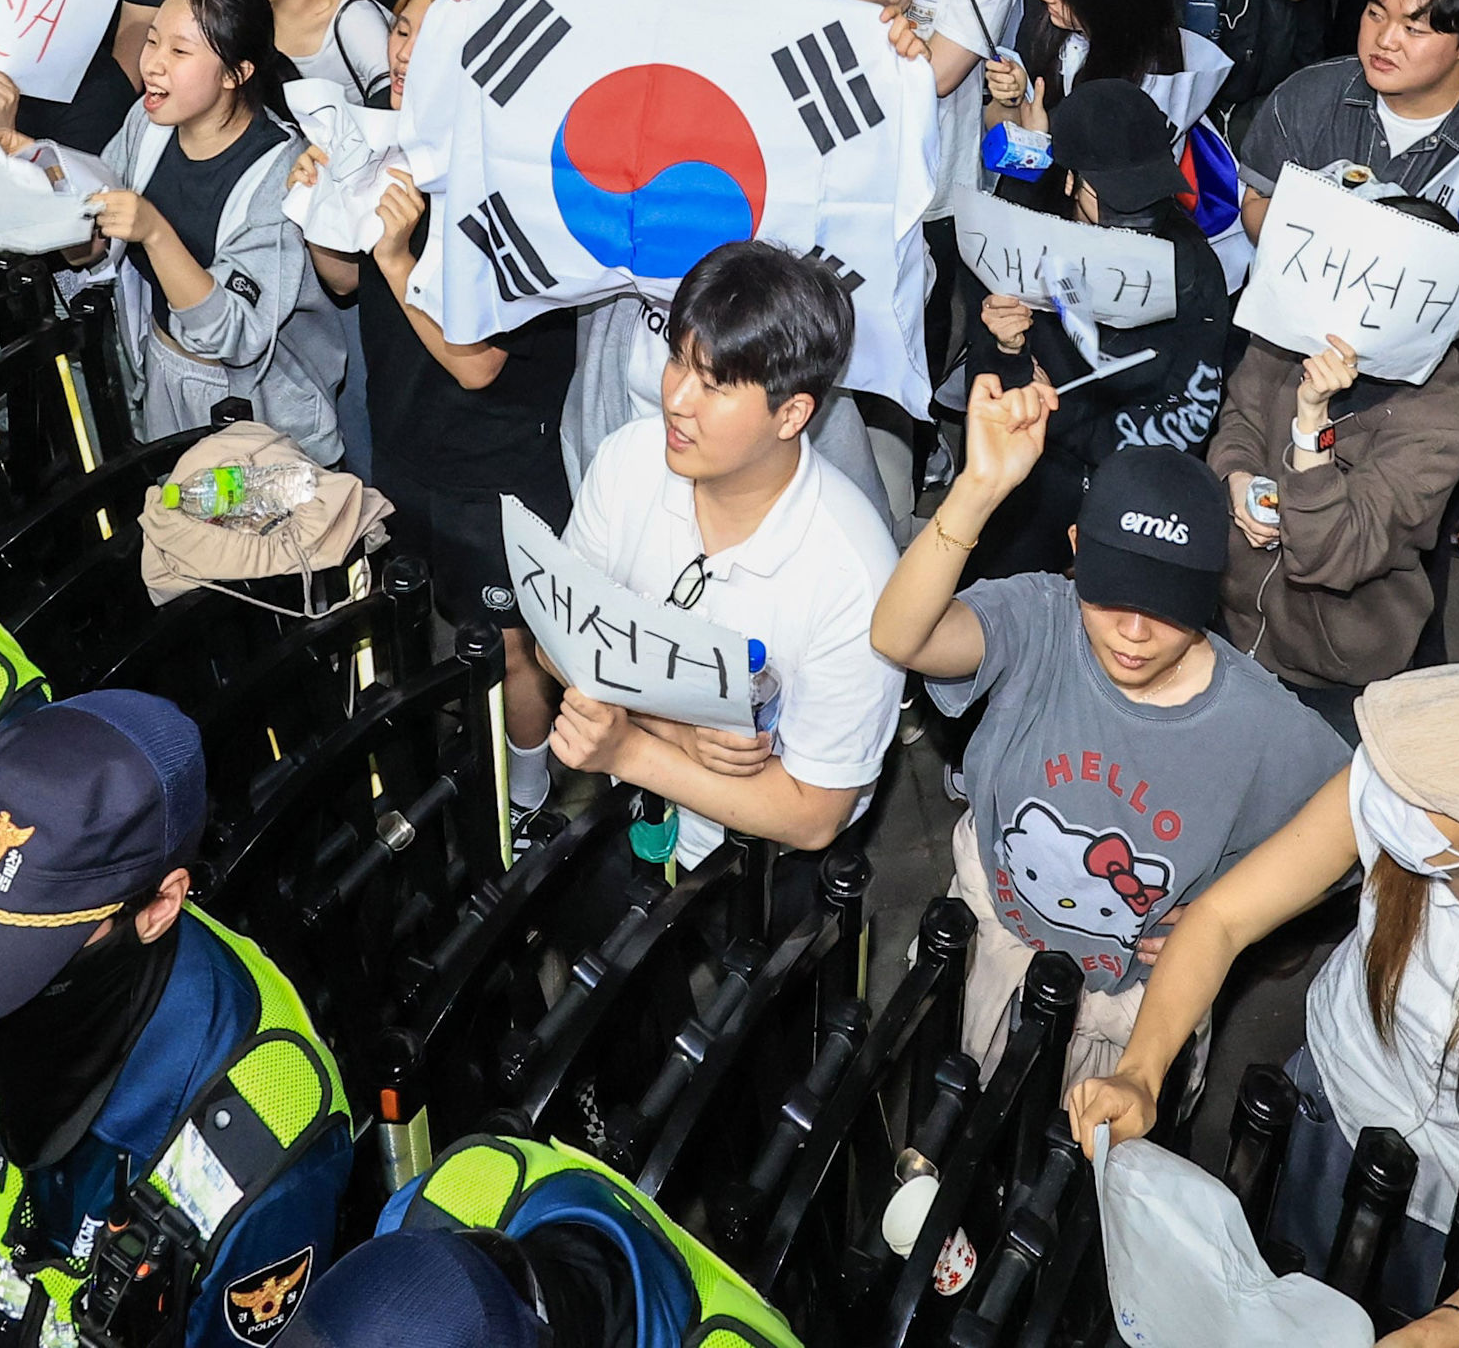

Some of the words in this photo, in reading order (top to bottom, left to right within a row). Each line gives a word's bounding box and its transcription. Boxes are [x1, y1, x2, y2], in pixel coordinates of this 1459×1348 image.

[1119, 508, 1192, 546] emis
[517, 544, 730, 699] 재선거
[1043, 748, 1184, 843] HELLO
[995, 868, 1015, 904] BE
[1004, 908, 1124, 979] FEAESS
[247, 1312, 286, 1336] POLICE
